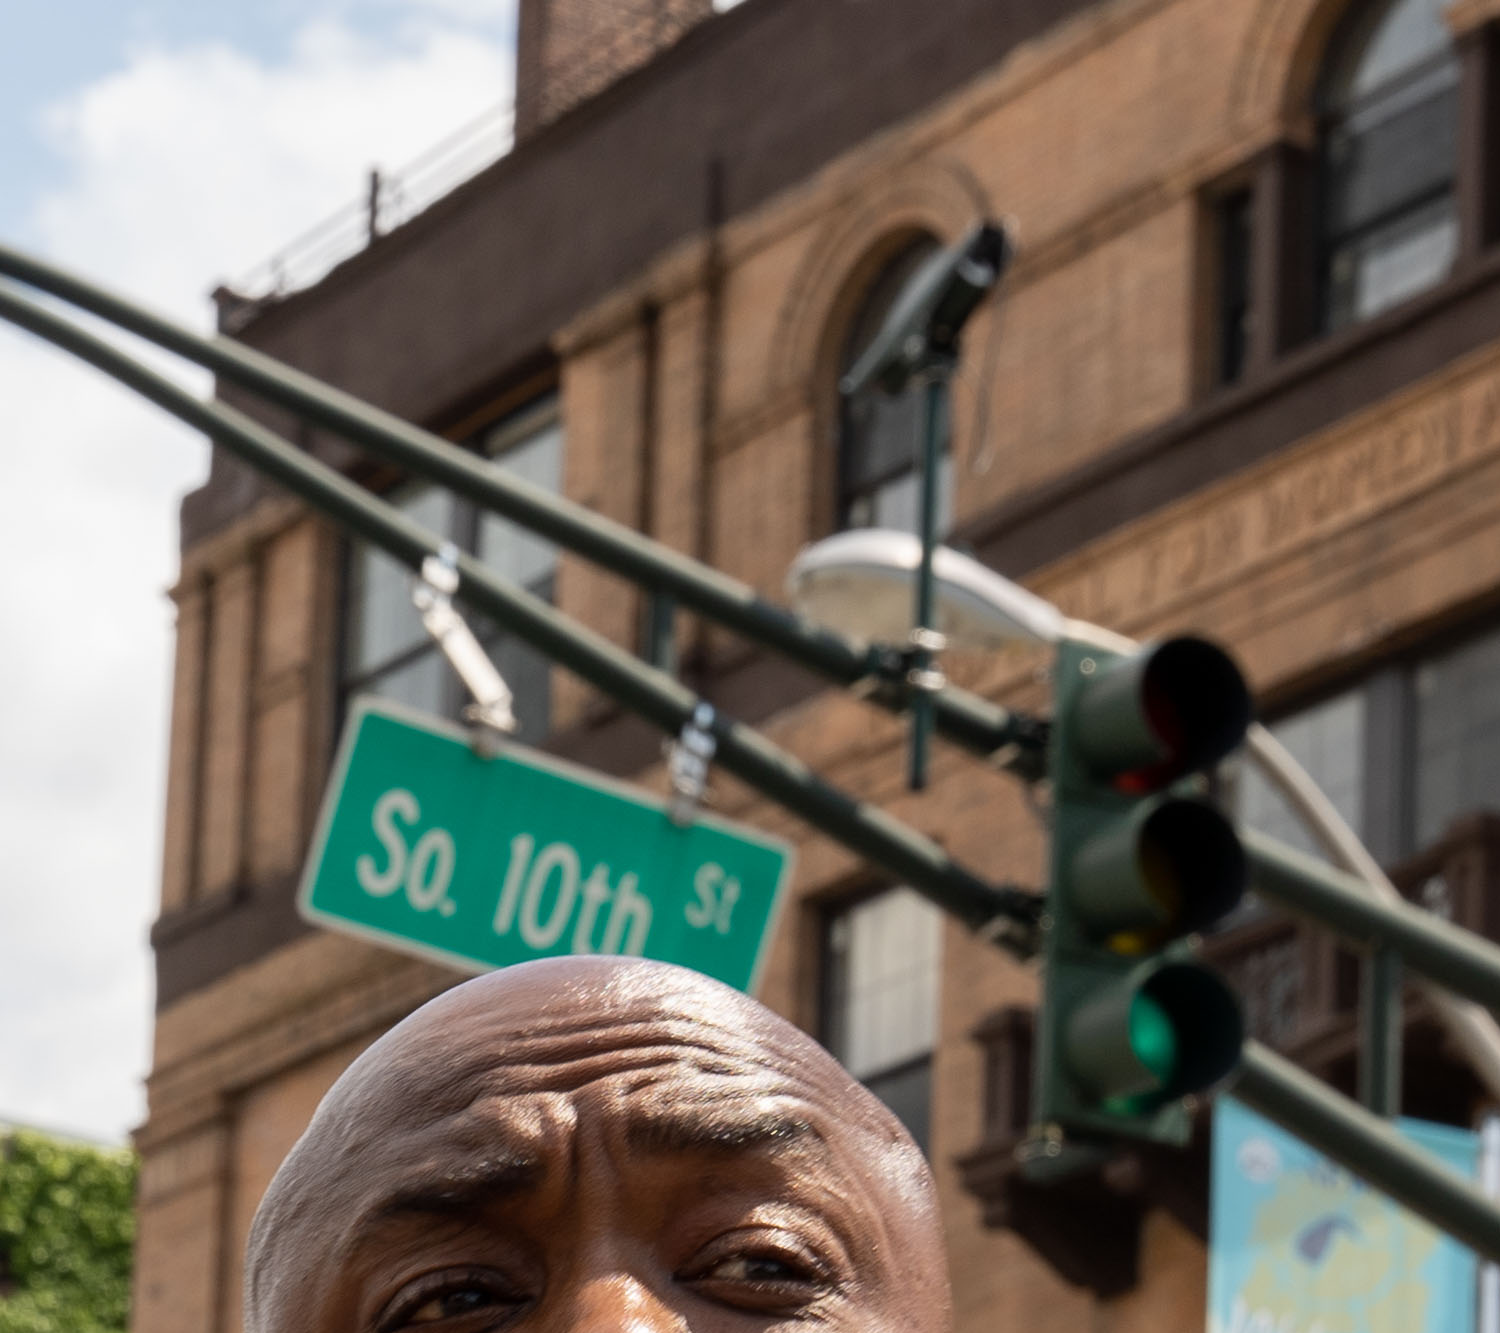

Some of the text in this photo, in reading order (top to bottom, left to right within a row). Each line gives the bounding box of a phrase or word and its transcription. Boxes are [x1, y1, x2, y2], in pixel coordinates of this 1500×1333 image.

[355, 787, 742, 957] So. 10th St
